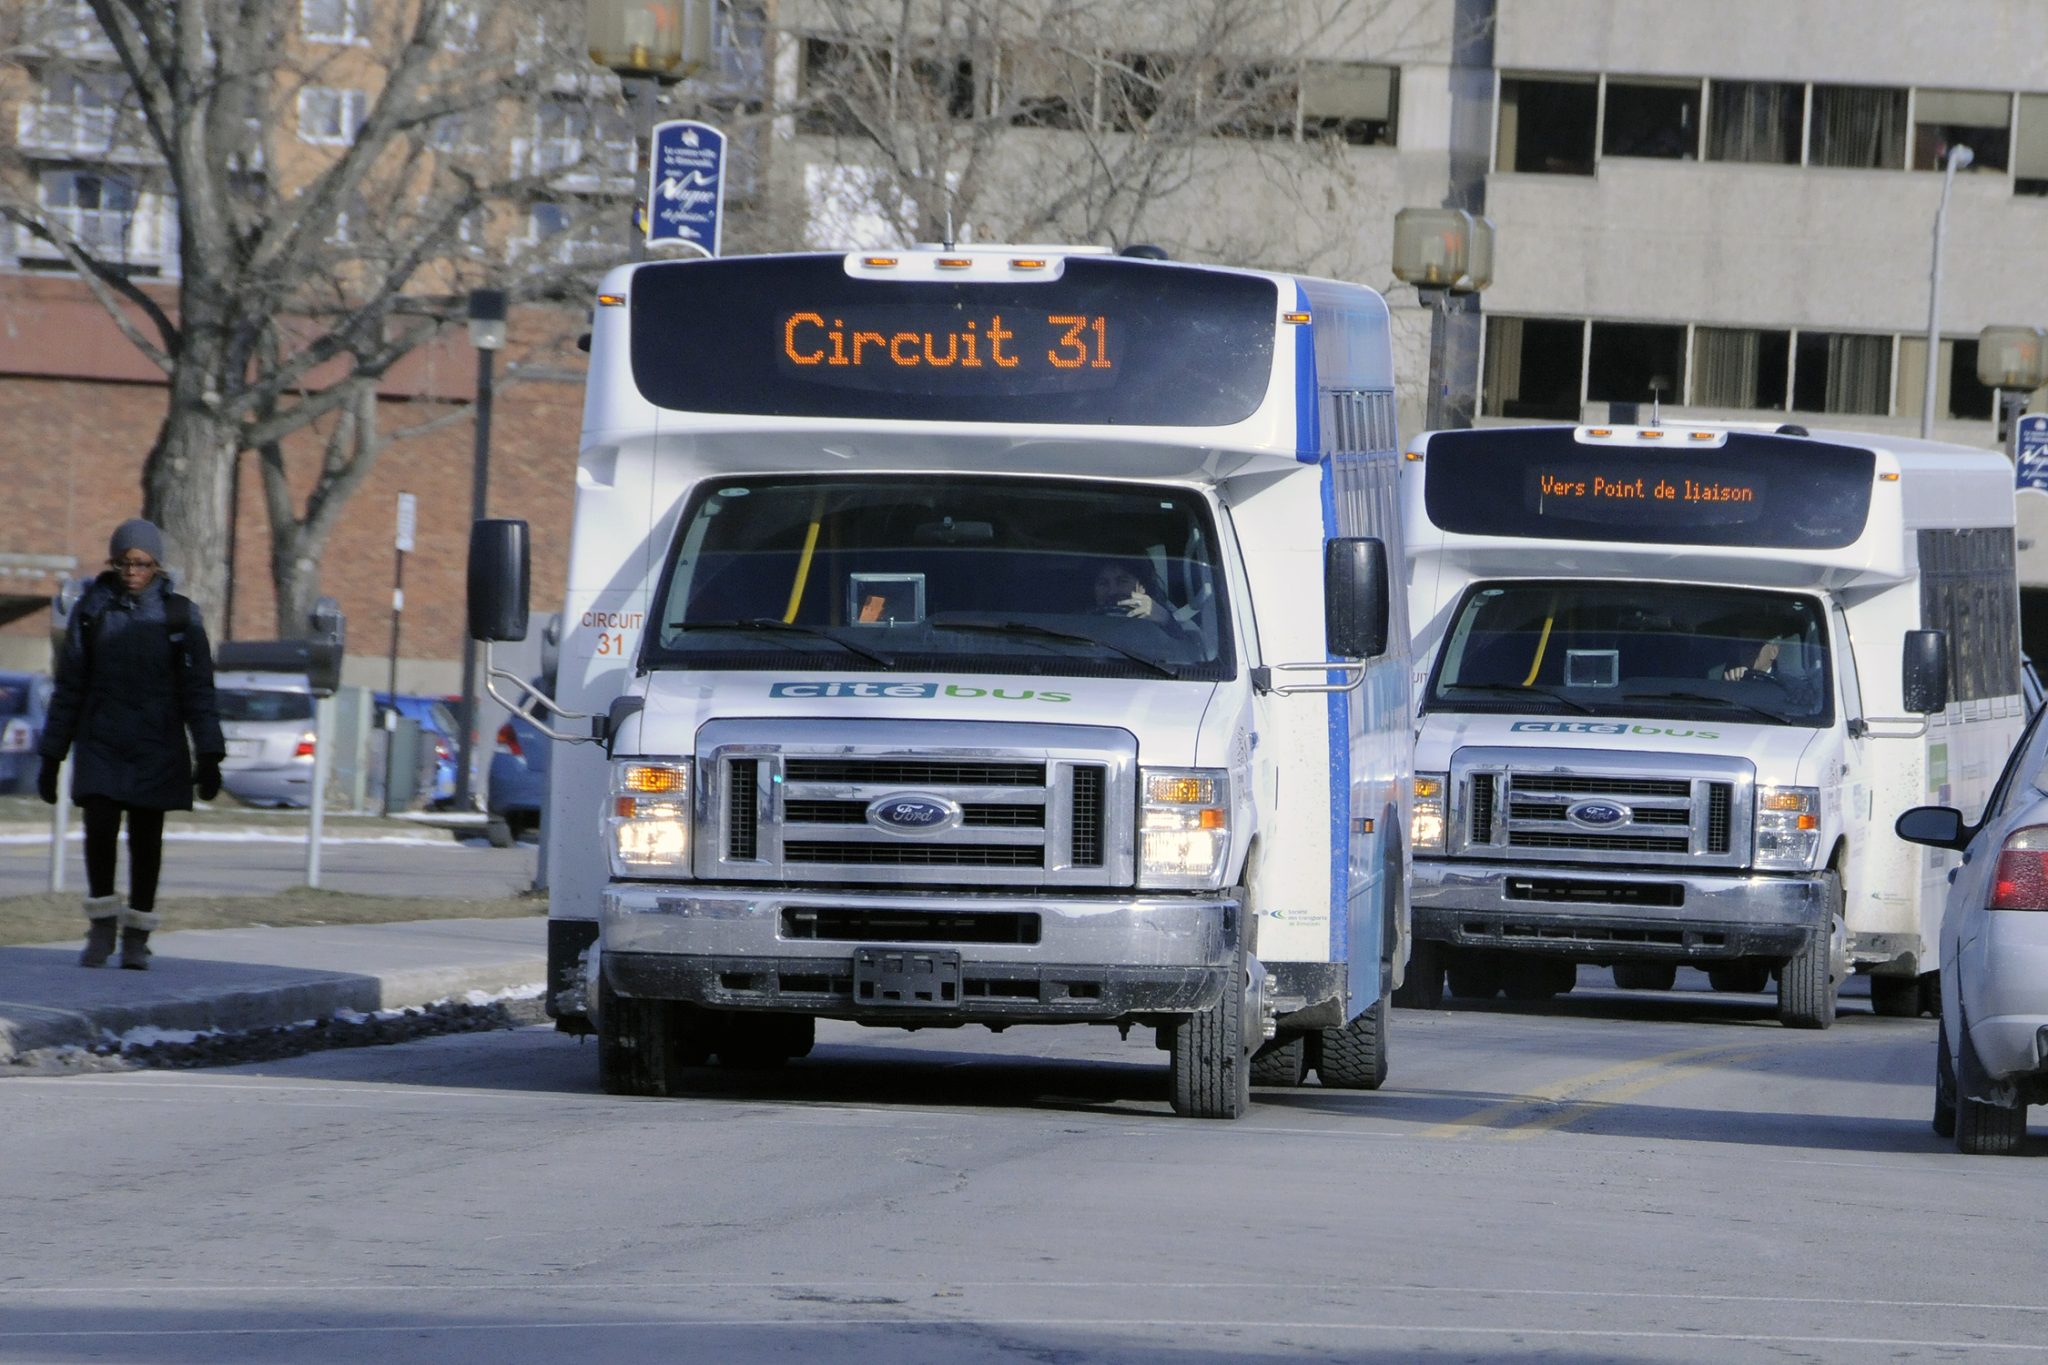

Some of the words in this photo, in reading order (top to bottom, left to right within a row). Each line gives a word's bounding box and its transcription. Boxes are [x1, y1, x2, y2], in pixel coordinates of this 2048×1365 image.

[785, 312, 1019, 367] Circuit
[1048, 315, 1112, 368] 31
[1541, 475, 1585, 496] Vers
[1594, 477, 1645, 498] Point
[1654, 480, 1675, 499] de
[1684, 480, 1752, 501] liaison
[582, 612, 643, 629] CIRCUIT
[597, 632, 623, 655] 31
[944, 684, 1072, 703] bus
[892, 803, 935, 822] Ford
[1583, 806, 1613, 820] Ford
